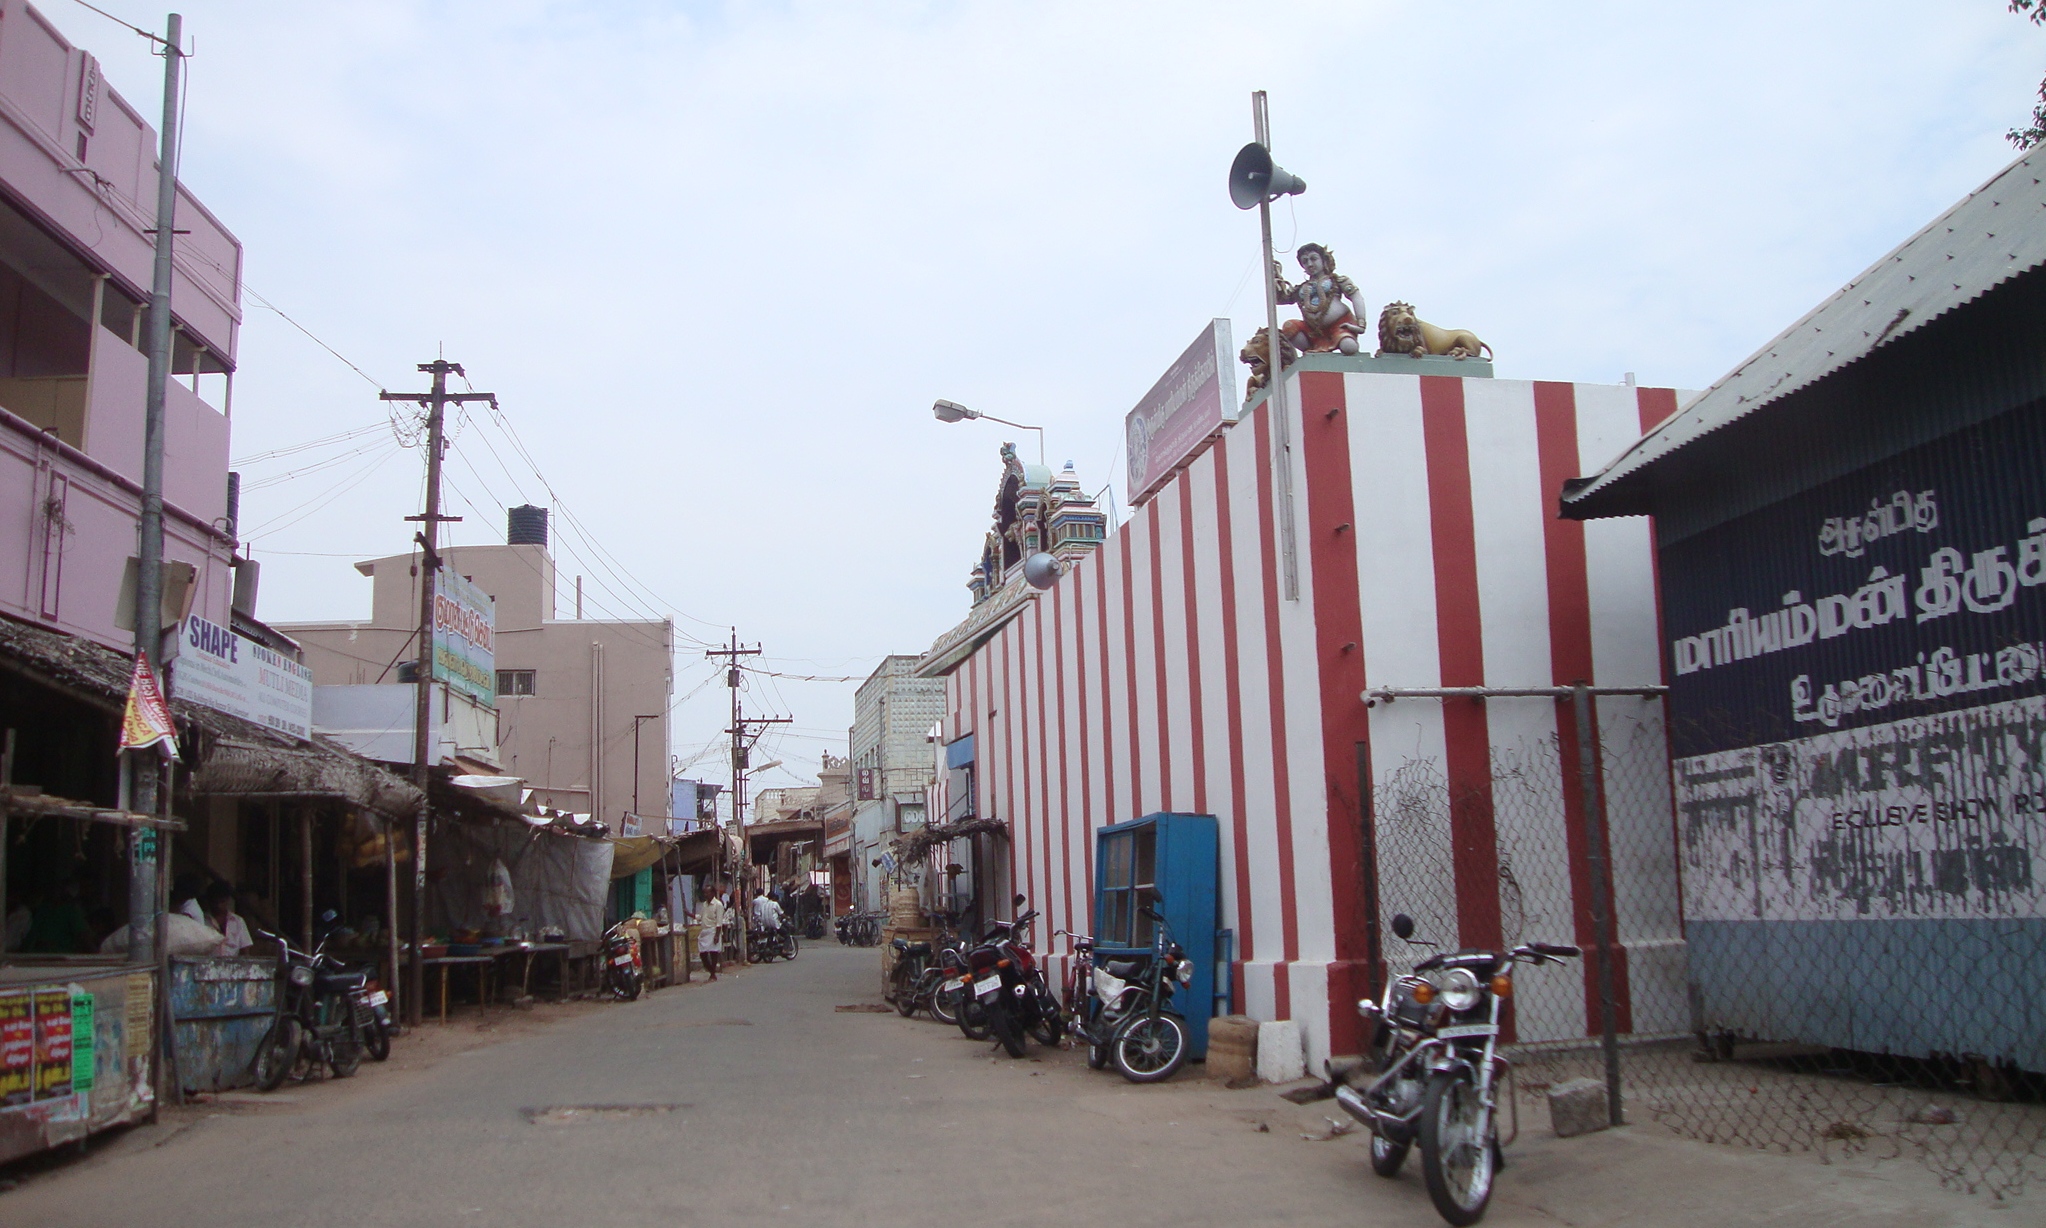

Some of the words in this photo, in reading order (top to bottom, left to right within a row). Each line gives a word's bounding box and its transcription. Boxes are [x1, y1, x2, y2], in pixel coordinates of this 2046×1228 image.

[1818, 489, 1939, 558] அருள்மிகு
[189, 614, 238, 665] SHAPE
[1674, 565, 1907, 676] மாரியம்மன்
